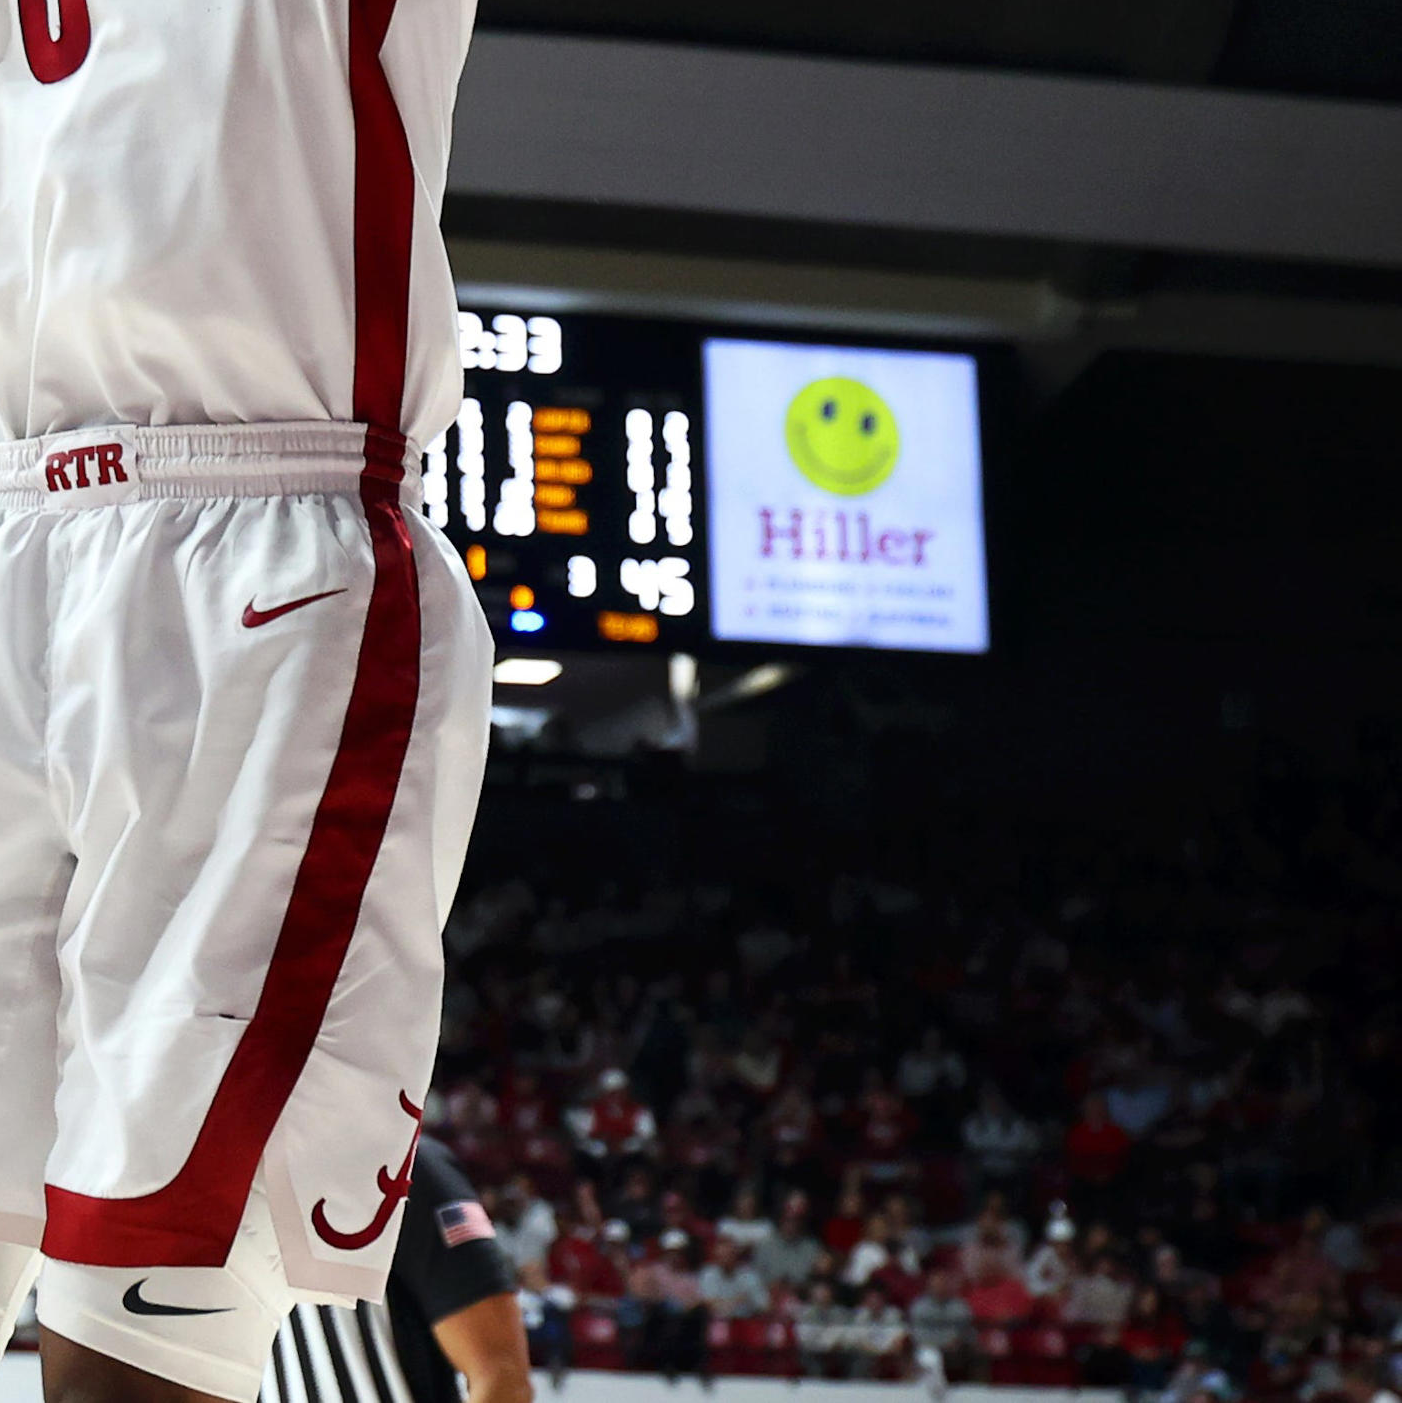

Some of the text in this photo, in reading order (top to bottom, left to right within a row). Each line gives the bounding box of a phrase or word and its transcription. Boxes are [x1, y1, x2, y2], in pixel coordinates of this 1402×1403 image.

[45, 443, 128, 493] RTR
[758, 507, 936, 566] Hiller
[620, 556, 695, 616] 45
